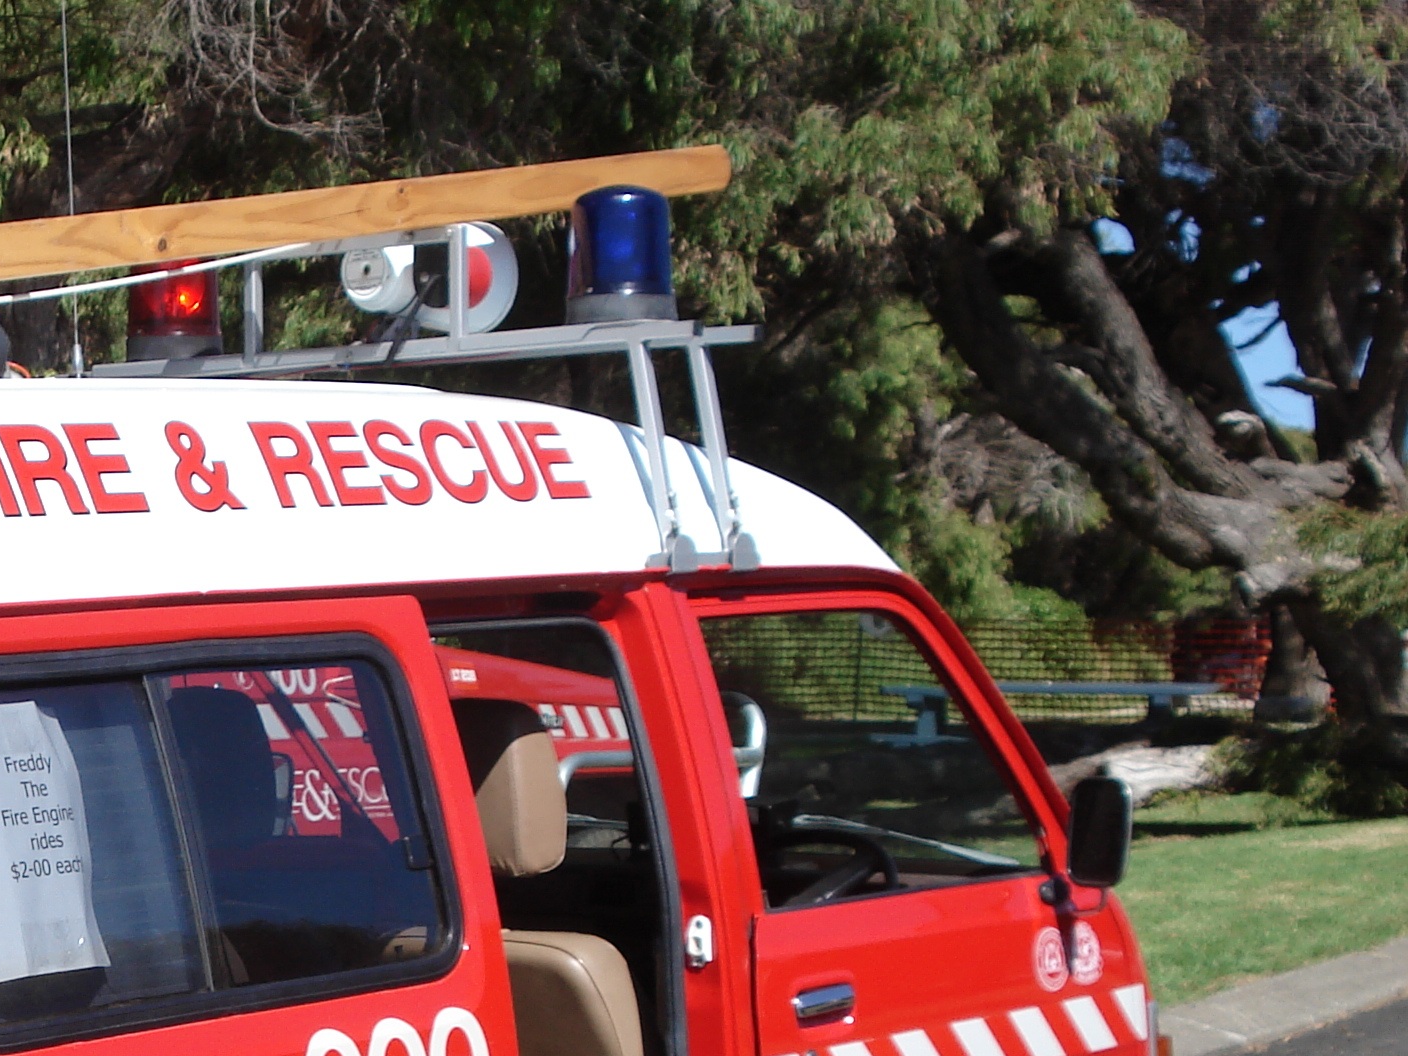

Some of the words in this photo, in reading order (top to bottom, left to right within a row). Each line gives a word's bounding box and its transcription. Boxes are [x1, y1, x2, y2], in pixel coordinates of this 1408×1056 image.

[165, 420, 247, 511] &
[248, 419, 593, 508] RESCUE
[4, 753, 52, 774] Freddy
[20, 780, 49, 798] The
[1, 809, 30, 827] Fire
[32, 804, 75, 826] Engine
[30, 832, 64, 851] rides
[11, 858, 52, 883] $2-00
